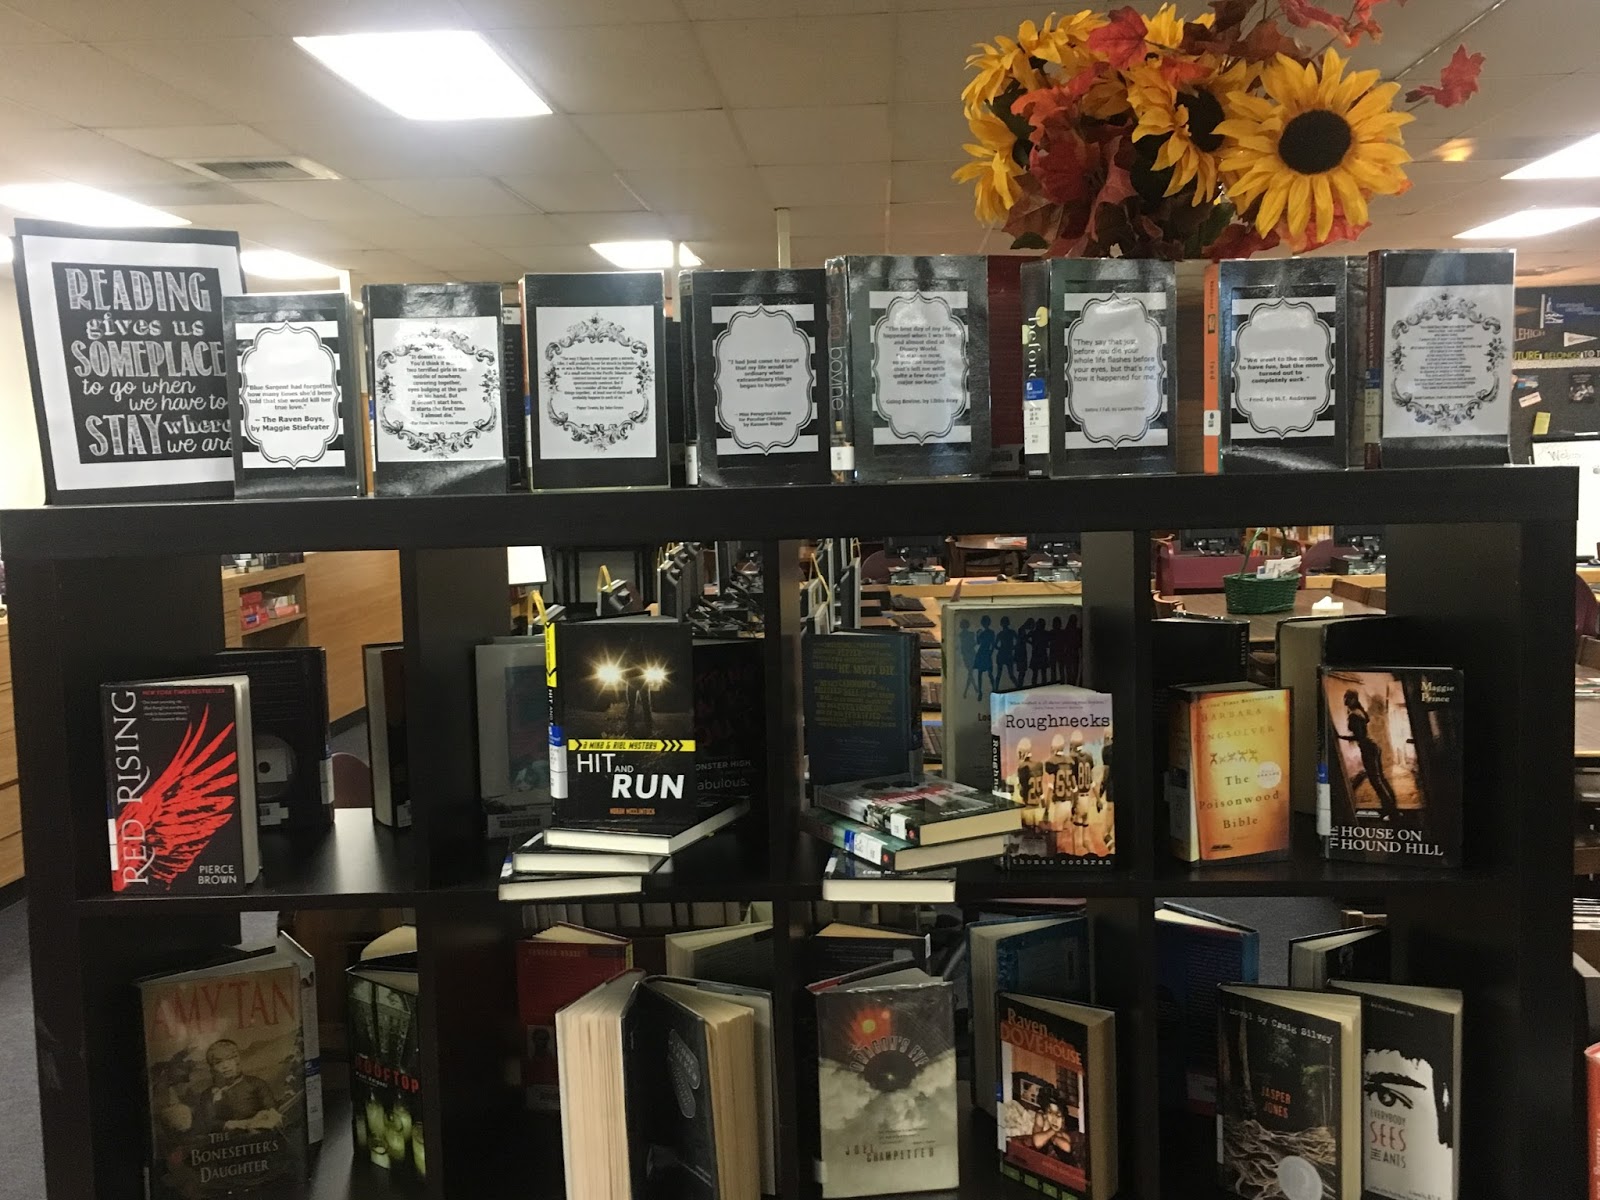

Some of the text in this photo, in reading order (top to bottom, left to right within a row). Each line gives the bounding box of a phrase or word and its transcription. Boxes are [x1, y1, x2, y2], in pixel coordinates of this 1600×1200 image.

[65, 268, 212, 312] READING
[86, 312, 204, 340] gives us
[71, 340, 227, 378] SOMEPLACE
[1584, 350, 1595, 358] TO
[830, 346, 846, 411] bovine
[1096, 374, 1130, 382] happened
[82, 378, 196, 402] to go when
[130, 394, 228, 412] we have to
[251, 424, 260, 432] by
[262, 424, 291, 432] Maggie
[304, 415, 325, 423] Boys,
[86, 414, 163, 456] STAY
[167, 438, 197, 453] we
[1420, 681, 1455, 693] Maggie
[1420, 692, 1450, 703] Prince
[1005, 714, 1110, 731] Roughnecks
[112, 690, 150, 805] RISING
[577, 753, 616, 773] HIT
[614, 765, 634, 773] AND
[696, 762, 728, 771] ONSTER
[992, 739, 1000, 790] Roughne
[697, 778, 749, 790] abulous.
[1078, 762, 1090, 789] 80
[1224, 775, 1250, 786] The
[611, 774, 685, 799] RUN
[1199, 790, 1280, 810] Poisonwood
[1222, 816, 1258, 829] Bible
[1329, 825, 1339, 848] THE
[1340, 826, 1422, 842] HOUSE ON
[122, 818, 156, 885] RED
[1340, 839, 1444, 856] HOUND HILL
[199, 864, 235, 874] PIERCE
[198, 875, 237, 885] BROWN
[154, 974, 296, 1029] AMY TAN
[1008, 1008, 1048, 1037] Raven
[1257, 1014, 1268, 1025] by
[1271, 1019, 1297, 1034] Craig
[1301, 1027, 1332, 1044] Silvey
[1000, 1021, 1082, 1065] DOVE HOUSE
[356, 1055, 419, 1093] ROOFTOP
[1262, 1086, 1291, 1104] JASPER
[1370, 1108, 1406, 1126] EVERYBODY
[208, 1132, 230, 1144] THE
[1370, 1121, 1406, 1152] SEES
[190, 1140, 279, 1166] BONESETTER'S
[1383, 1150, 1406, 1168] ANTS
[200, 1159, 269, 1183] DAUGHTER
